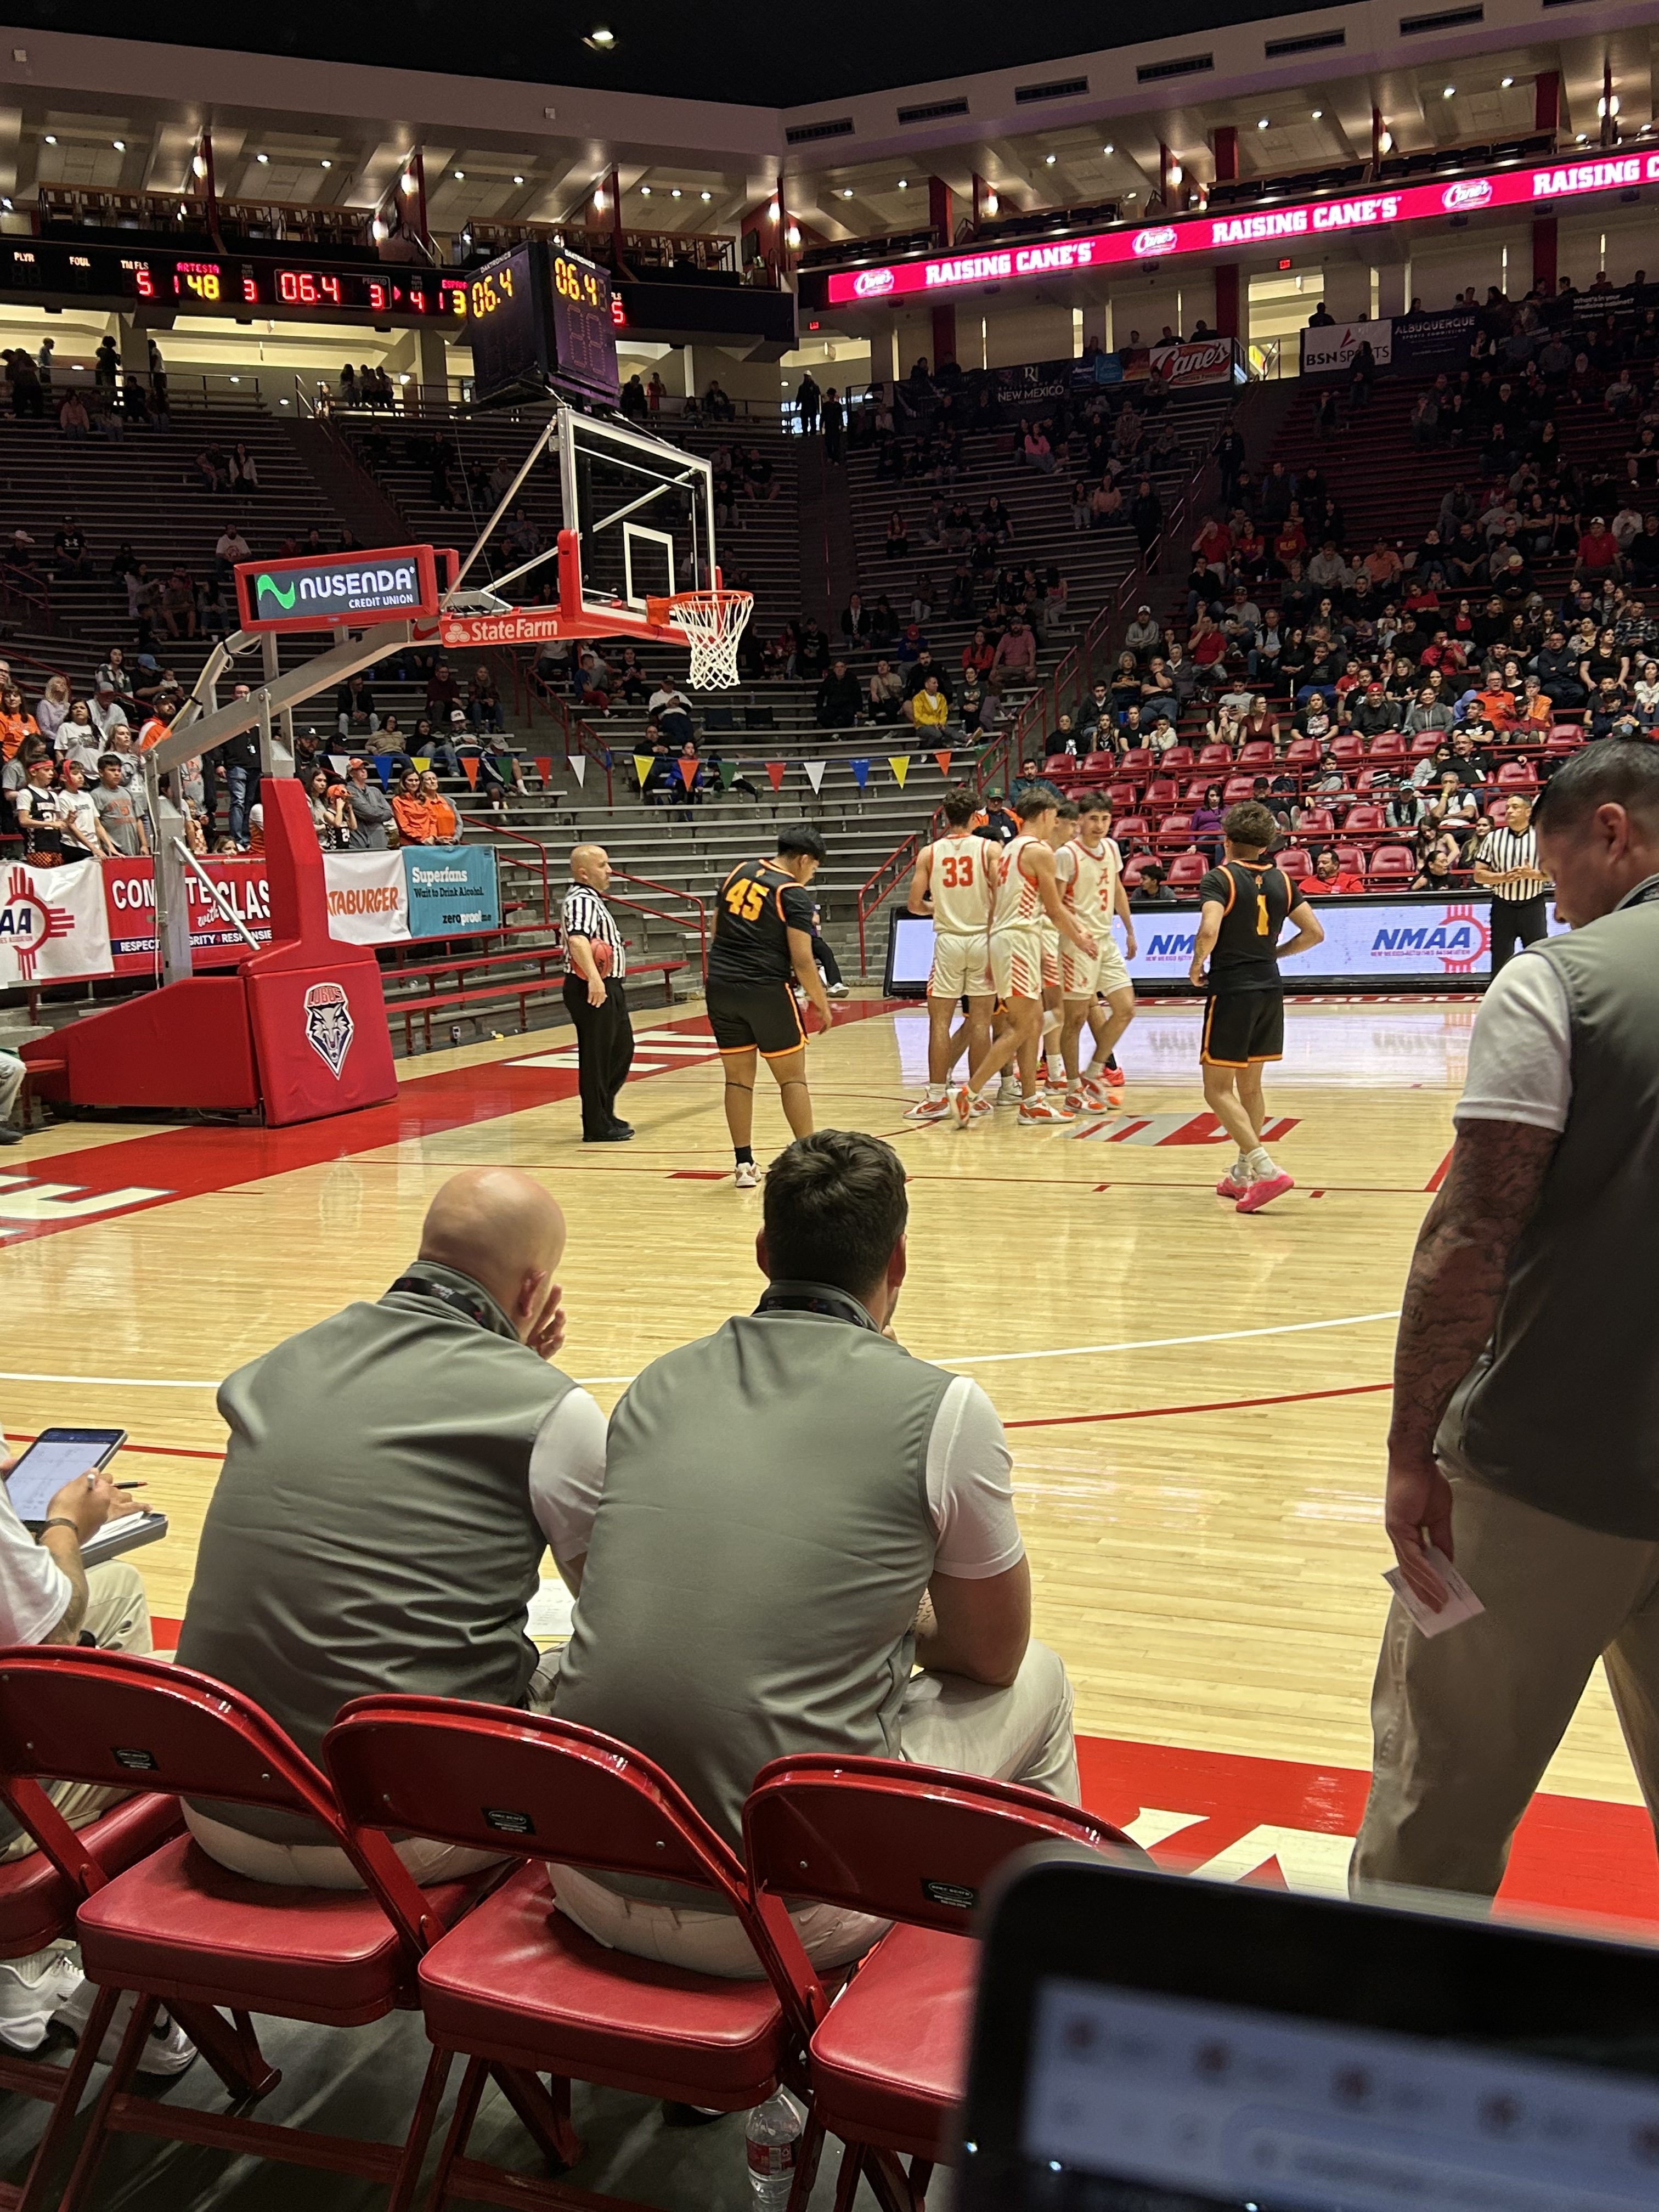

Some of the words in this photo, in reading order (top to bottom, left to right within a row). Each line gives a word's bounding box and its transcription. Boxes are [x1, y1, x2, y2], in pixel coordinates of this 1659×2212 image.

[1534, 164, 1640, 195] RAISING
[1212, 211, 1306, 242] RAISING
[1313, 197, 1397, 229] CANE'S
[14, 252, 35, 262] PLYR
[69, 256, 90, 267] FOUL
[120, 260, 133, 269] TM
[134, 262, 149, 270] FLS
[176, 262, 219, 273] ARTESIA
[926, 255, 1011, 285] RAISING
[1016, 242, 1092, 272] CANE'S
[137, 272, 151, 296] 5
[244, 279, 256, 301] 3
[281, 273, 338, 302] 06.4
[362, 277, 387, 285] PERIOD
[555, 257, 597, 306] 06.4
[370, 284, 383, 307] 3
[410, 291, 423, 309] 4
[453, 290, 467, 314] 3
[472, 268, 512, 318] 06.4
[612, 301, 624, 323] 5
[1395, 316, 1475, 334] ALBUQUERQUE
[1156, 342, 1229, 382] Cane's
[1306, 352, 1337, 366] BSN
[1339, 346, 1390, 362] SPTS
[998, 390, 1022, 403] NEW
[1024, 385, 1064, 399] MEXICO
[300, 569, 412, 600] NUSENDA
[348, 596, 380, 608] CREDIT
[382, 594, 414, 607] UNION
[412, 866, 469, 887] Superfans
[942, 856, 974, 888] 33
[217, 880, 271, 922] CLAS
[328, 887, 398, 917] TABURGER
[414, 887, 432, 898] Wait
[432, 888, 439, 898] to
[439, 887, 459, 898] Drink
[725, 878, 770, 921] 45
[1098, 889, 1108, 912] 3
[0, 908, 31, 935] AA
[1256, 894, 1269, 936] 1
[120, 939, 160, 952] RESPECT
[1146, 935, 1196, 955] NM
[1372, 927, 1470, 950] NMAA
[307, 986, 346, 1007] LOBOS
